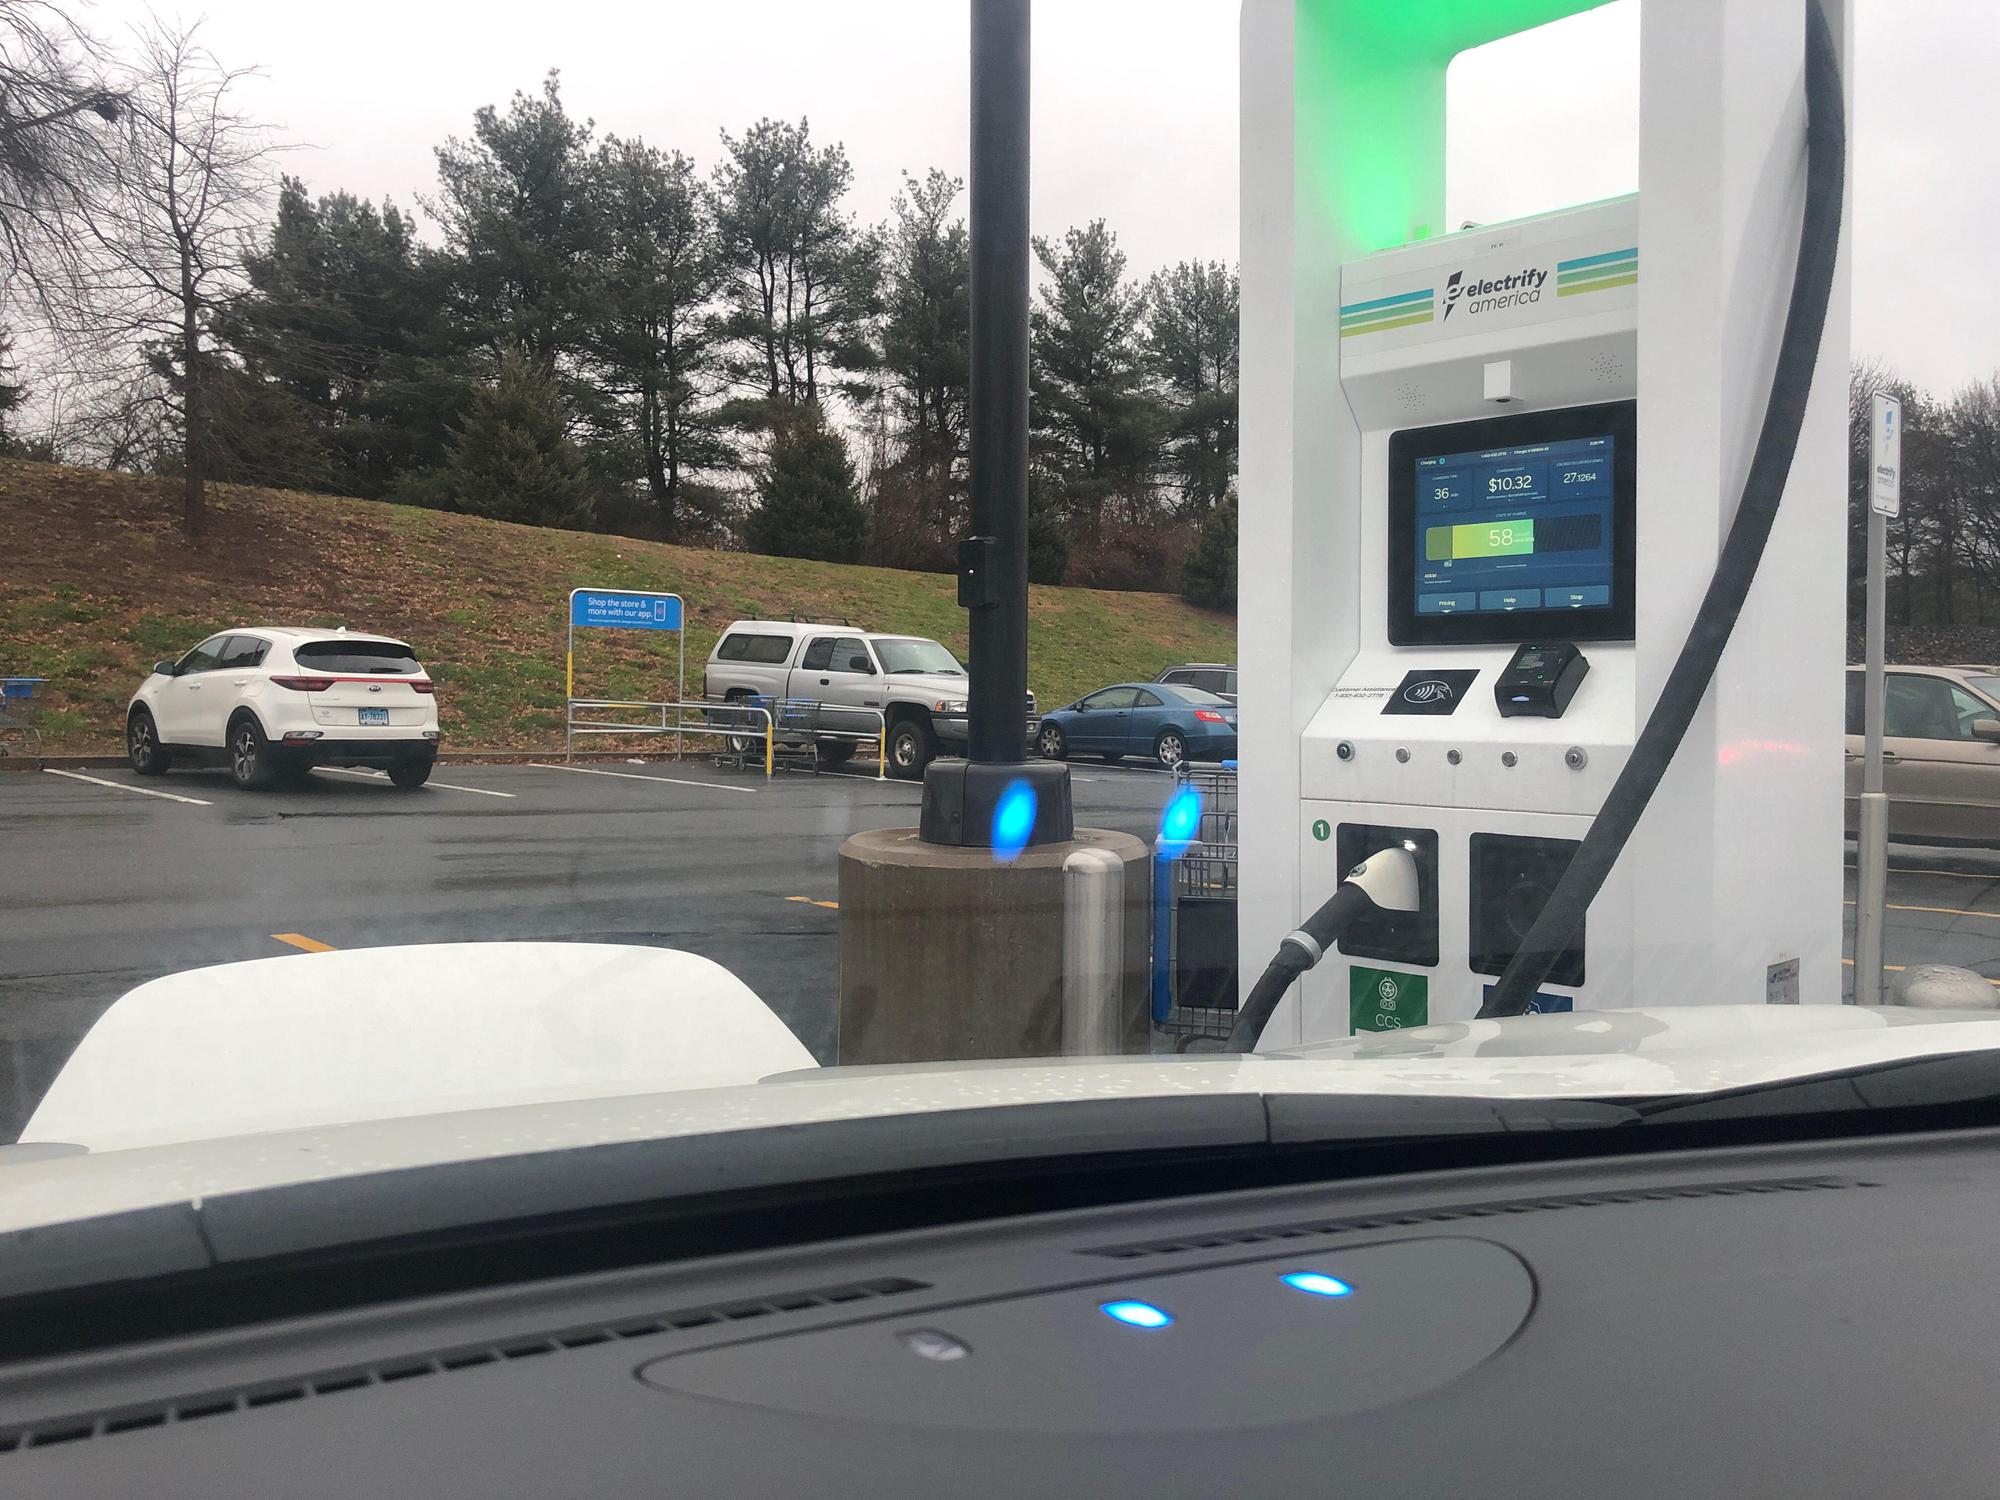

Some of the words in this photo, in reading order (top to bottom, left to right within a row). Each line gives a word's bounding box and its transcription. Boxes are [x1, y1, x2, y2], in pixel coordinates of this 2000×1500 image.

[1466, 268, 1548, 297] electrify
[1469, 289, 1541, 314] america
[1488, 475, 1532, 493] $10.32
[1434, 487, 1449, 500] 36
[1489, 528, 1513, 547] 58
[588, 597, 606, 607] Shop
[607, 598, 620, 607] the
[620, 600, 640, 608] store
[640, 600, 647, 608] &
[608, 608, 624, 616] with
[1317, 823, 1325, 837] 1
[1375, 1013, 1401, 1029] CCS
